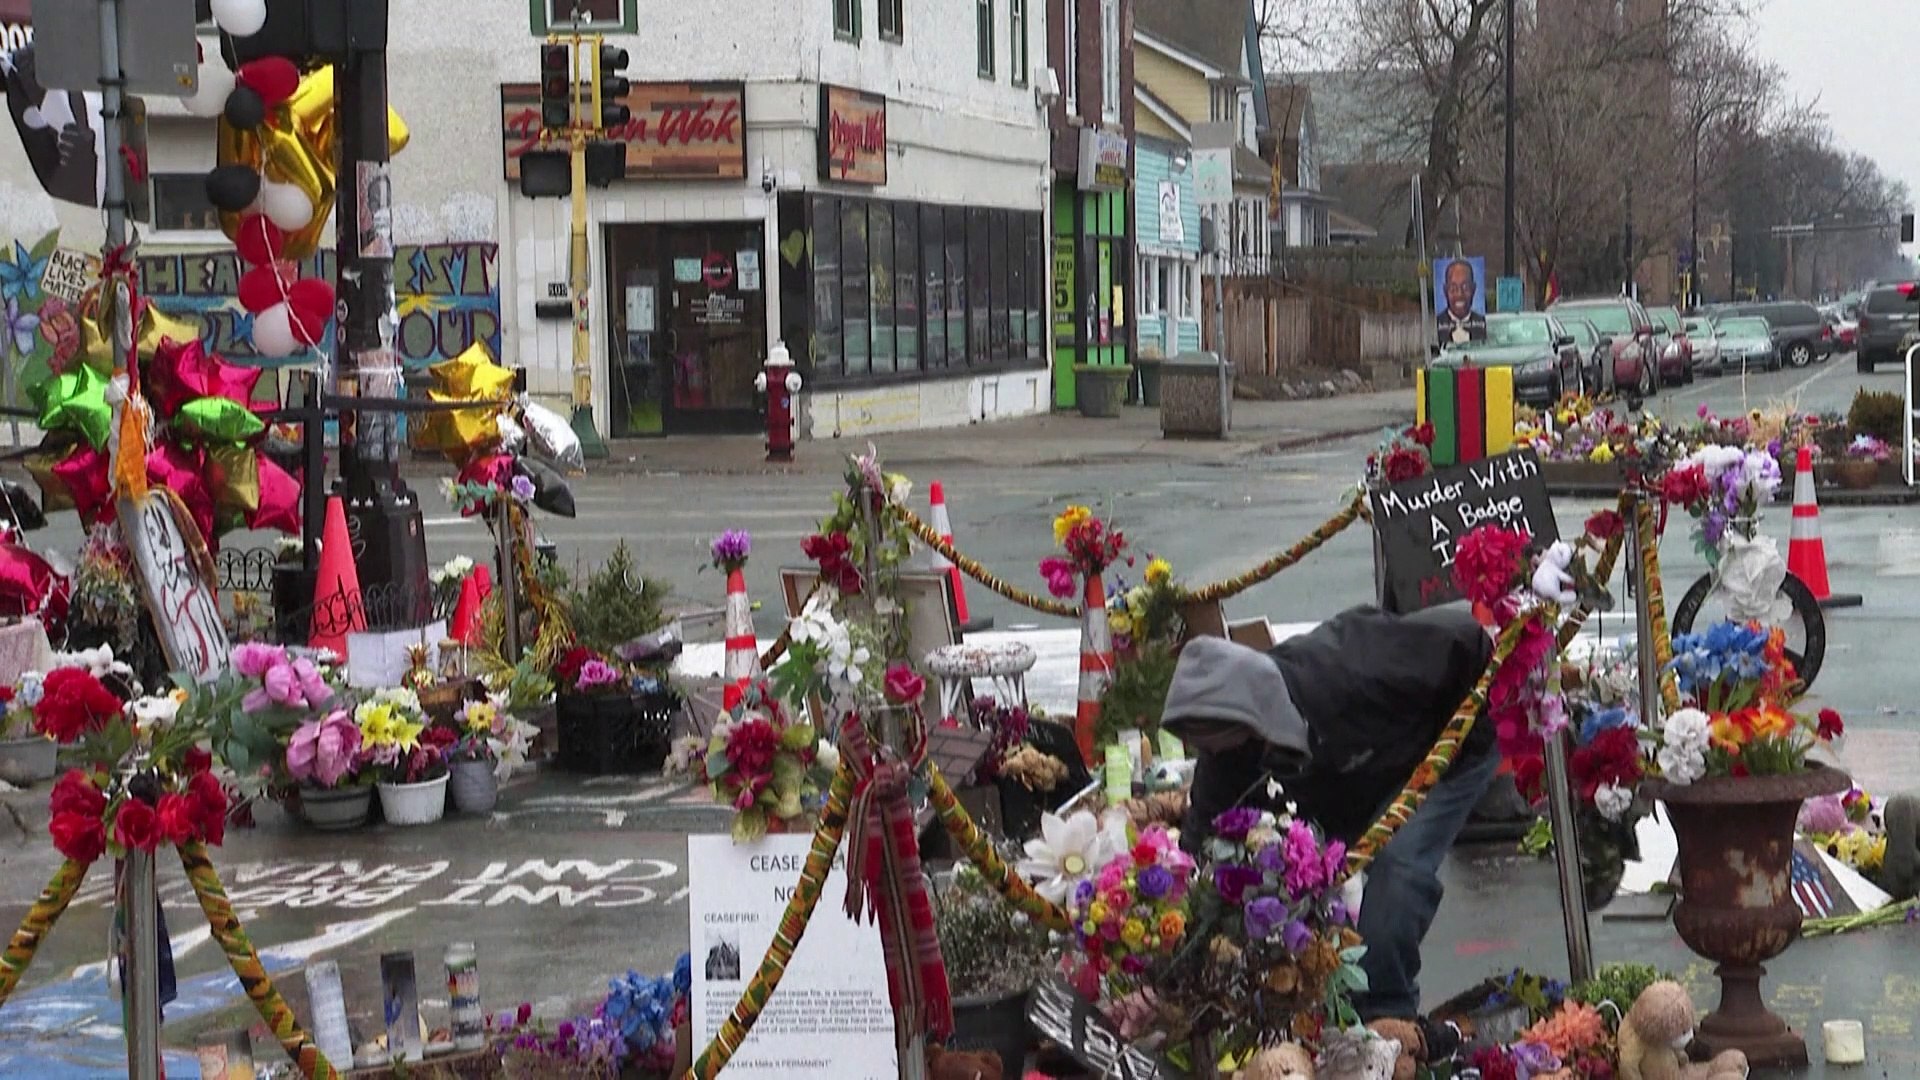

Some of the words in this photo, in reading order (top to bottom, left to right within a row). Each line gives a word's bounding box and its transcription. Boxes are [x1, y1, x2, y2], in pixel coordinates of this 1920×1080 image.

[656, 98, 739, 147] Wok
[48, 266, 86, 288] LIVES
[52, 250, 87, 273] BLACK
[43, 278, 84, 301] MATTER
[400, 308, 498, 360] OUR
[1379, 478, 1465, 519] Murder
[1469, 453, 1538, 491] With
[1430, 514, 1450, 541] A
[1457, 495, 1524, 529] Badge
[750, 854, 799, 872] CEASE
